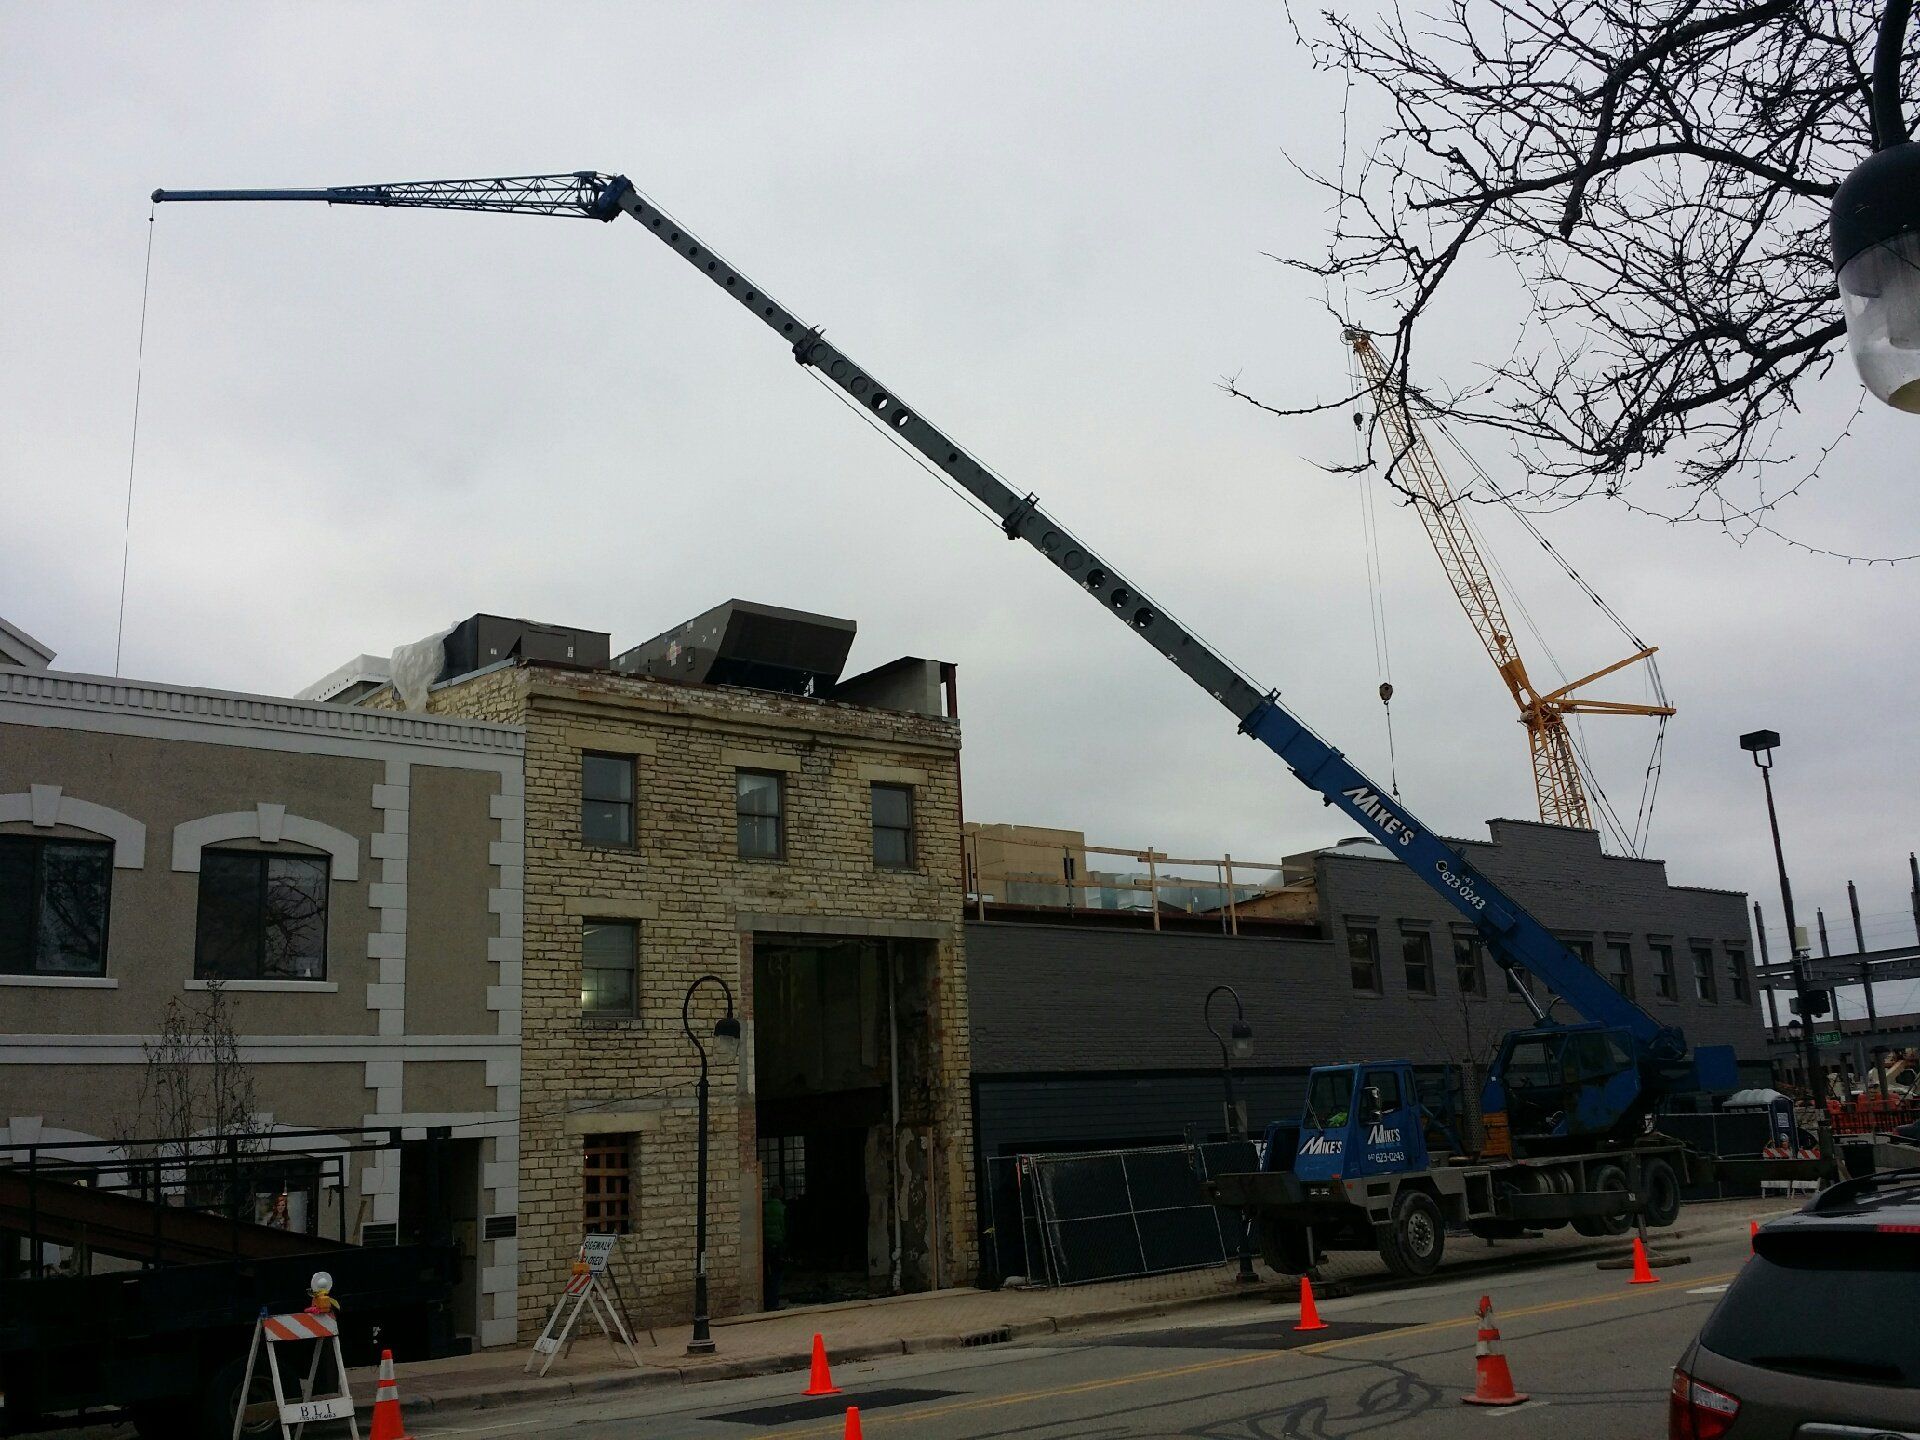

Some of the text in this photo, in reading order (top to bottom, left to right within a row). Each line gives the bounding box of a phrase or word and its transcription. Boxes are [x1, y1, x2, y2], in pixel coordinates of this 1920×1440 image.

[1342, 786, 1415, 846] MIKE'S
[1367, 1124, 1401, 1145] MIKE'S
[1298, 1136, 1343, 1155] MIKE'S
[584, 1241, 611, 1251] SIDEWALK
